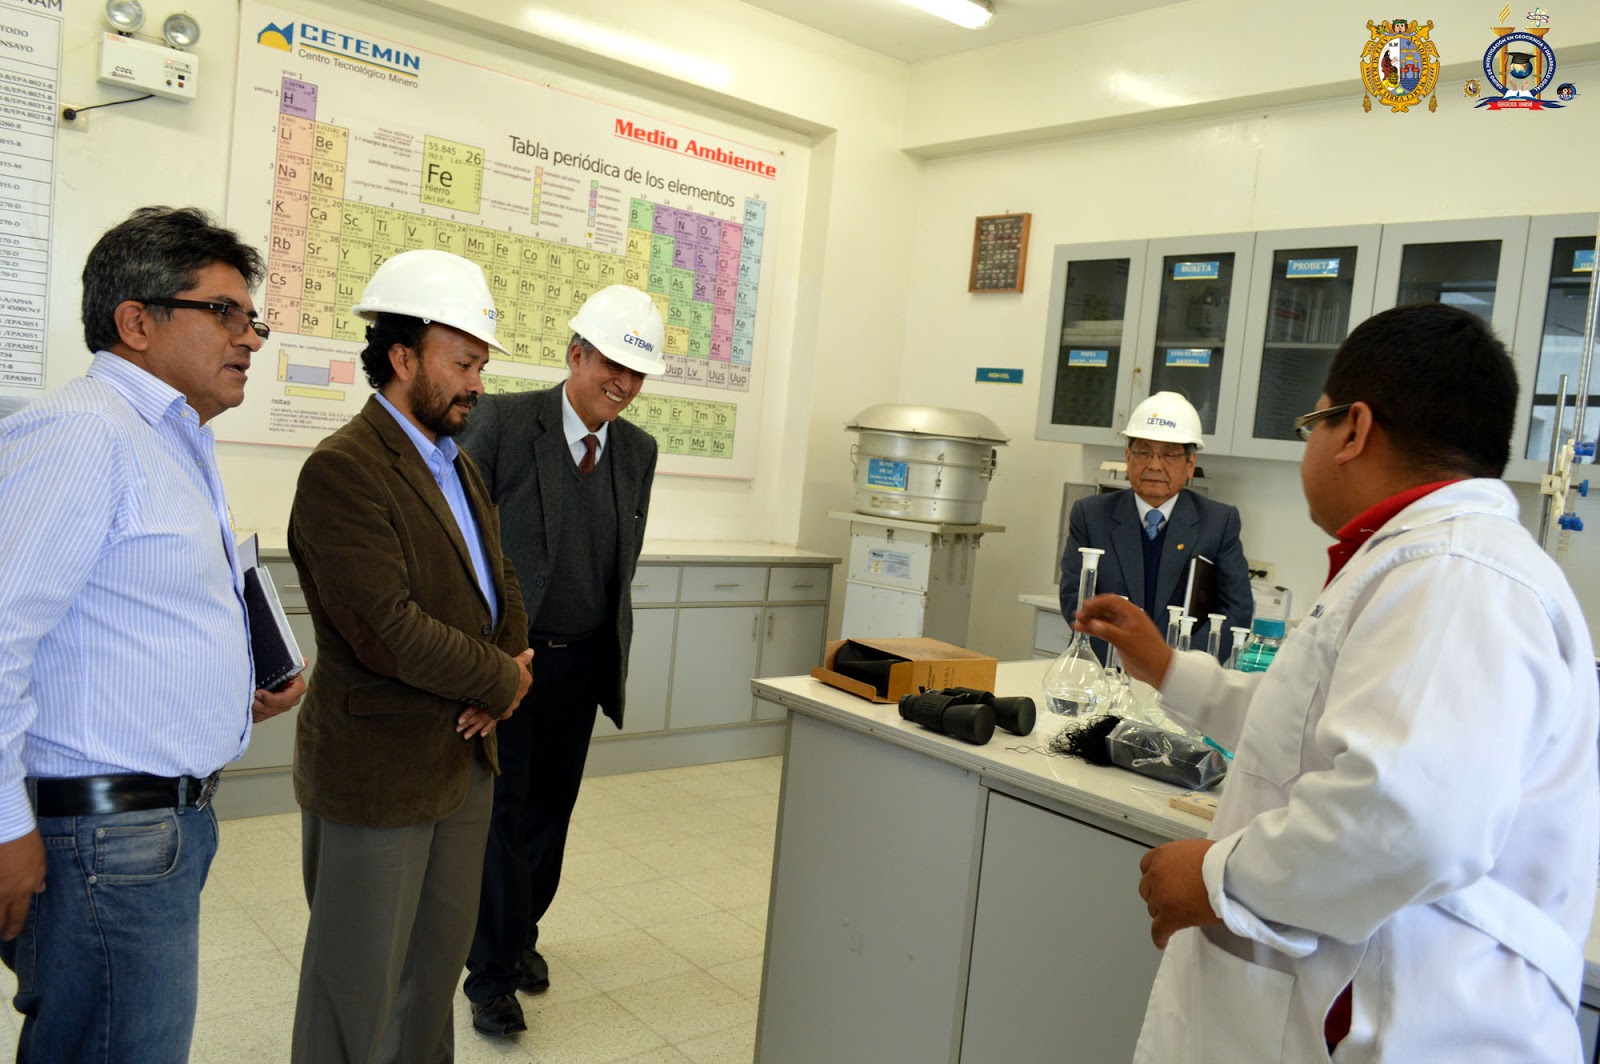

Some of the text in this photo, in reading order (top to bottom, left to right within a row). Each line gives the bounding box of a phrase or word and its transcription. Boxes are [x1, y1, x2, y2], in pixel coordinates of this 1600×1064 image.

[23, 0, 62, 11] AM
[300, 23, 420, 70] CETEMIN
[298, 48, 418, 89] Centro Tecnológico Minero
[284, 92, 294, 104] H
[282, 128, 292, 140] Li
[316, 136, 333, 149] Be
[615, 117, 777, 178] Medio Ambiente
[428, 142, 456, 155] 55.845
[466, 151, 481, 165] 26
[278, 164, 296, 178] Na
[428, 163, 452, 188] Fe
[509, 135, 549, 160] Tabla
[553, 149, 620, 179] periódica
[624, 166, 642, 184] de
[645, 171, 665, 189] los
[668, 177, 736, 207] elementos
[425, 184, 450, 196] Hierro
[276, 201, 284, 212] K
[310, 207, 327, 220] Ca
[632, 210, 637, 219] B
[746, 210, 757, 219] He
[344, 214, 358, 226] Sc
[655, 216, 661, 225] C
[678, 221, 684, 230] N
[377, 220, 387, 232] Ti
[408, 226, 416, 237] V
[700, 226, 707, 235] O
[438, 232, 452, 244] Cr
[722, 231, 728, 239] F
[273, 237, 290, 250] Rb
[468, 238, 484, 250] Mn
[628, 240, 638, 249] Al
[743, 236, 754, 246] Ne
[308, 243, 321, 255] Sr
[341, 248, 349, 259] Y
[496, 244, 508, 255] Fe
[653, 246, 661, 255] Si
[676, 250, 681, 258] P
[524, 249, 538, 261] Co
[550, 254, 560, 265] Ni
[698, 255, 703, 264] S
[576, 260, 589, 270] Cu
[601, 264, 614, 275] Zn
[719, 260, 728, 269] Cl
[741, 264, 749, 273] Ar
[270, 273, 286, 285] Cs
[626, 269, 639, 281] Ga
[650, 274, 662, 284] Ge
[305, 278, 321, 290] Ba
[494, 275, 507, 287] Ru
[521, 280, 535, 292] Rh
[673, 279, 684, 289] As
[339, 284, 352, 295] Lu
[548, 285, 560, 296] Pd
[695, 283, 706, 293] Se
[717, 287, 726, 296] Br
[573, 290, 587, 303] Ag
[738, 292, 747, 300] Kr
[268, 308, 280, 320] Fr
[518, 312, 526, 321] Ir
[670, 307, 682, 318] Sb
[692, 311, 702, 321] Te
[302, 313, 318, 326] Ra
[336, 318, 348, 330] Lr
[545, 316, 555, 326] Pt
[714, 315, 717, 323] I
[736, 318, 746, 328] Xe
[624, 334, 654, 352] CETEMIN
[667, 336, 676, 345] Bi
[690, 340, 700, 349] Po
[516, 343, 529, 354] Mt
[542, 347, 556, 358] Ds
[712, 343, 720, 352] At
[733, 346, 744, 355] Rn
[665, 364, 683, 376] Uup
[687, 368, 698, 377] Lv
[709, 370, 725, 380] Uus
[730, 374, 746, 384] Uuo
[626, 403, 639, 415] Dy
[650, 405, 662, 415] Ho
[672, 408, 681, 417] Er
[694, 410, 708, 420] Tm
[716, 413, 726, 422] Yb
[1147, 418, 1176, 428] CETEMIN
[670, 436, 683, 447] Fm
[692, 438, 705, 448] Md
[714, 440, 725, 450] No
